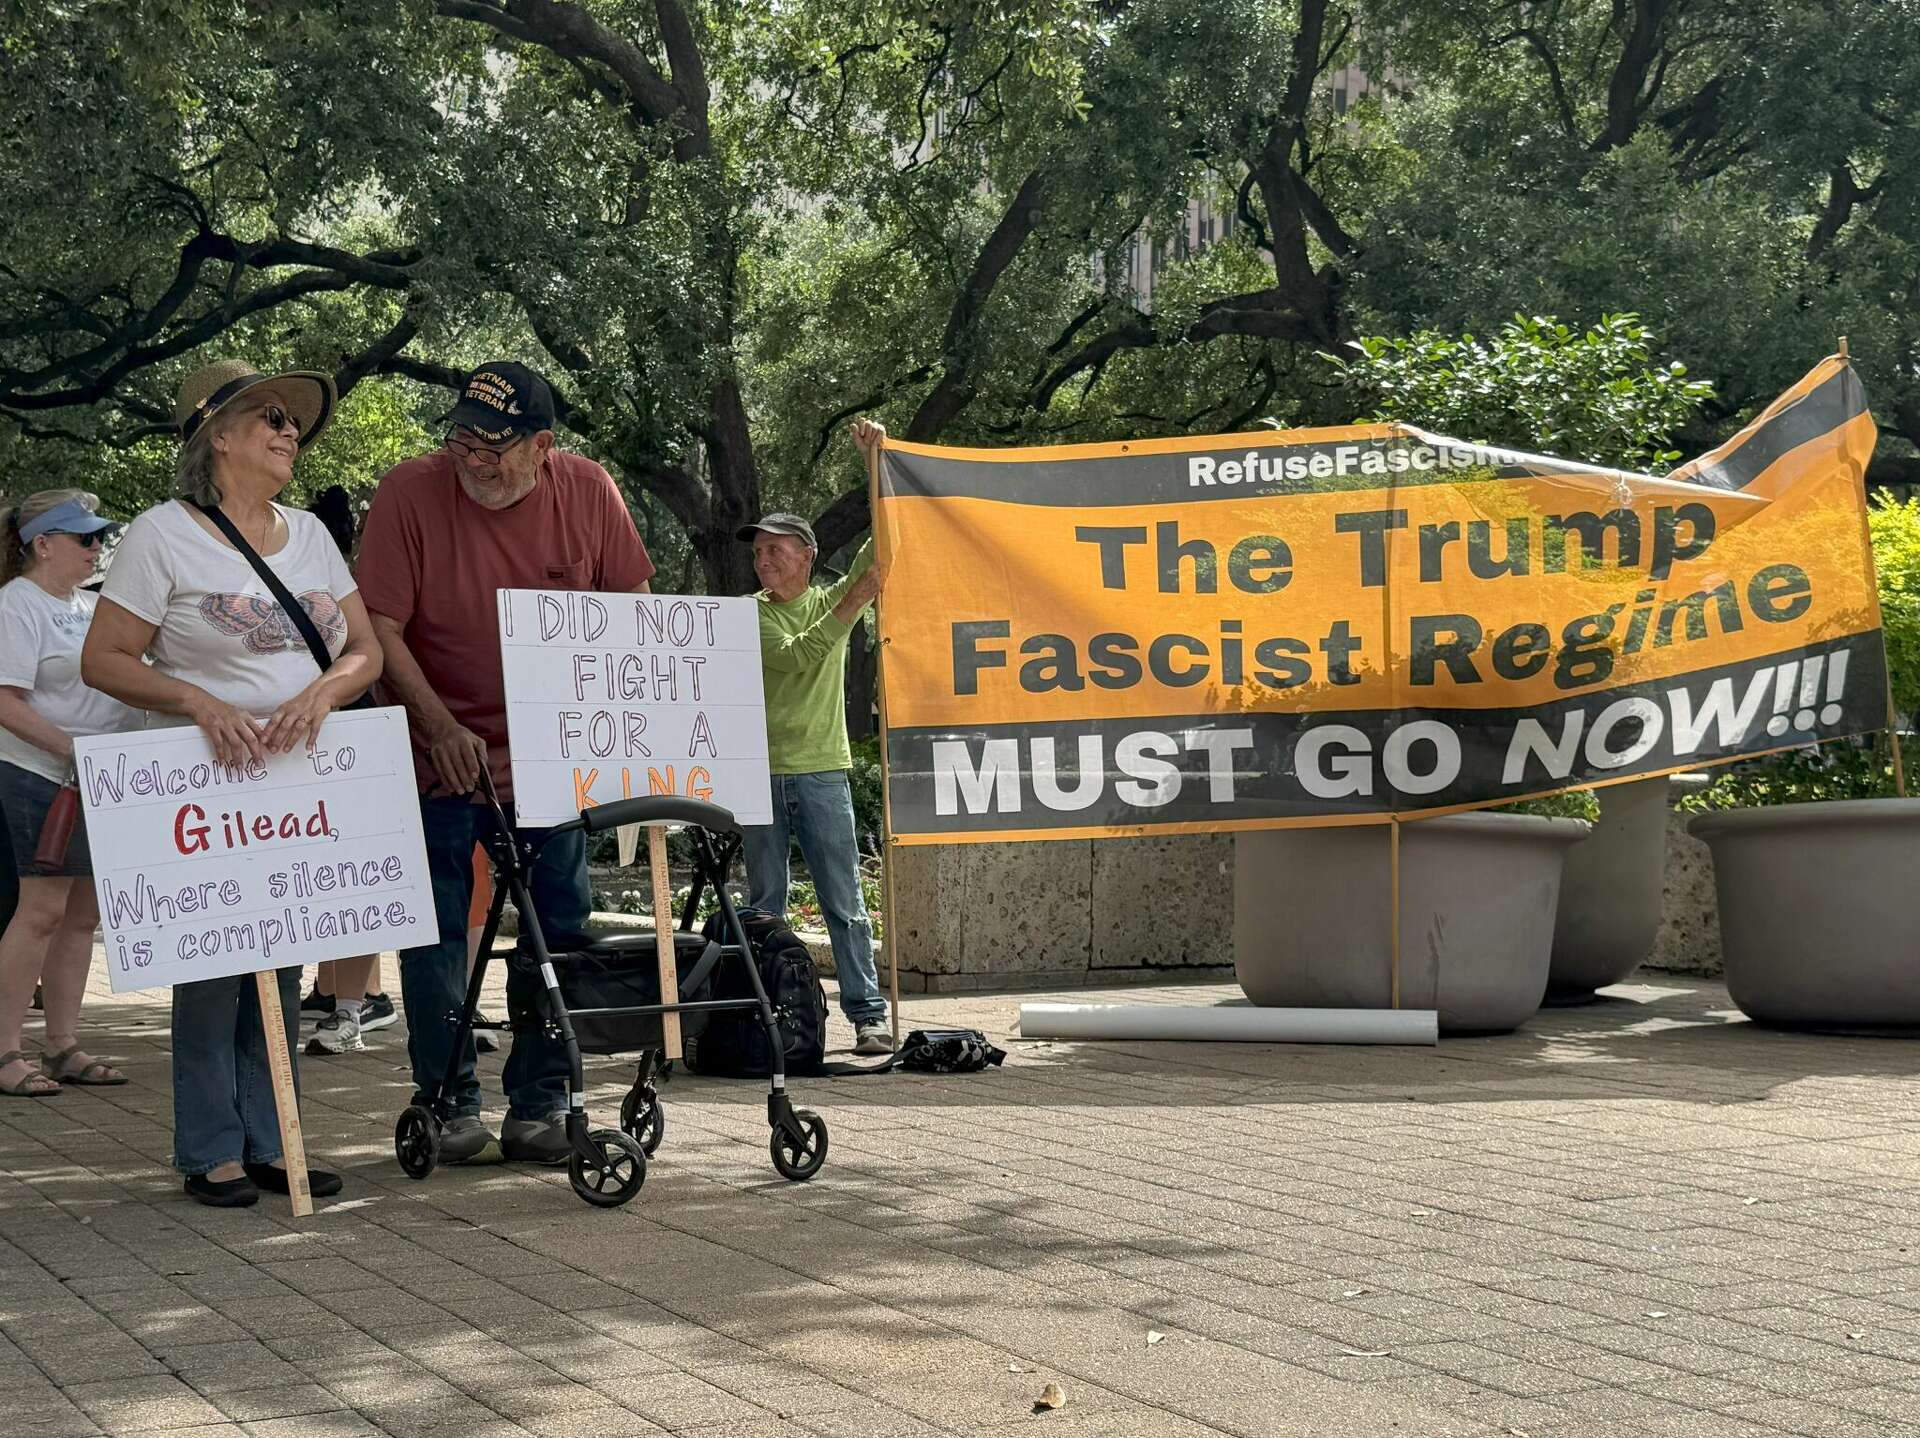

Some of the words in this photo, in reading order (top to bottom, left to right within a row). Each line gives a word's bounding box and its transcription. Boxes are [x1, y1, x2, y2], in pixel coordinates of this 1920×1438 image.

[465, 389, 506, 411] VETERAN
[472, 372, 516, 396] VIETNAM
[1075, 520, 1294, 594] The
[1335, 502, 1716, 588] Trump
[504, 589, 513, 638] I
[537, 592, 608, 643] DID
[635, 599, 720, 647] NOT
[951, 619, 1363, 696] Fascist
[1409, 563, 1812, 690] Regime
[573, 653, 706, 702] FIGHT
[558, 710, 651, 759] FOR
[688, 711, 717, 758] A
[932, 727, 1254, 816] MUST
[1294, 719, 1462, 799] GO
[1501, 648, 1851, 786] NOW!!!
[83, 752, 268, 808] Welcome
[307, 741, 357, 776] to
[573, 764, 714, 813] KING
[173, 800, 340, 856] Gilead,
[102, 873, 241, 930] Where
[268, 853, 403, 898] silence
[115, 937, 154, 971] is
[177, 898, 417, 958] compliance.
